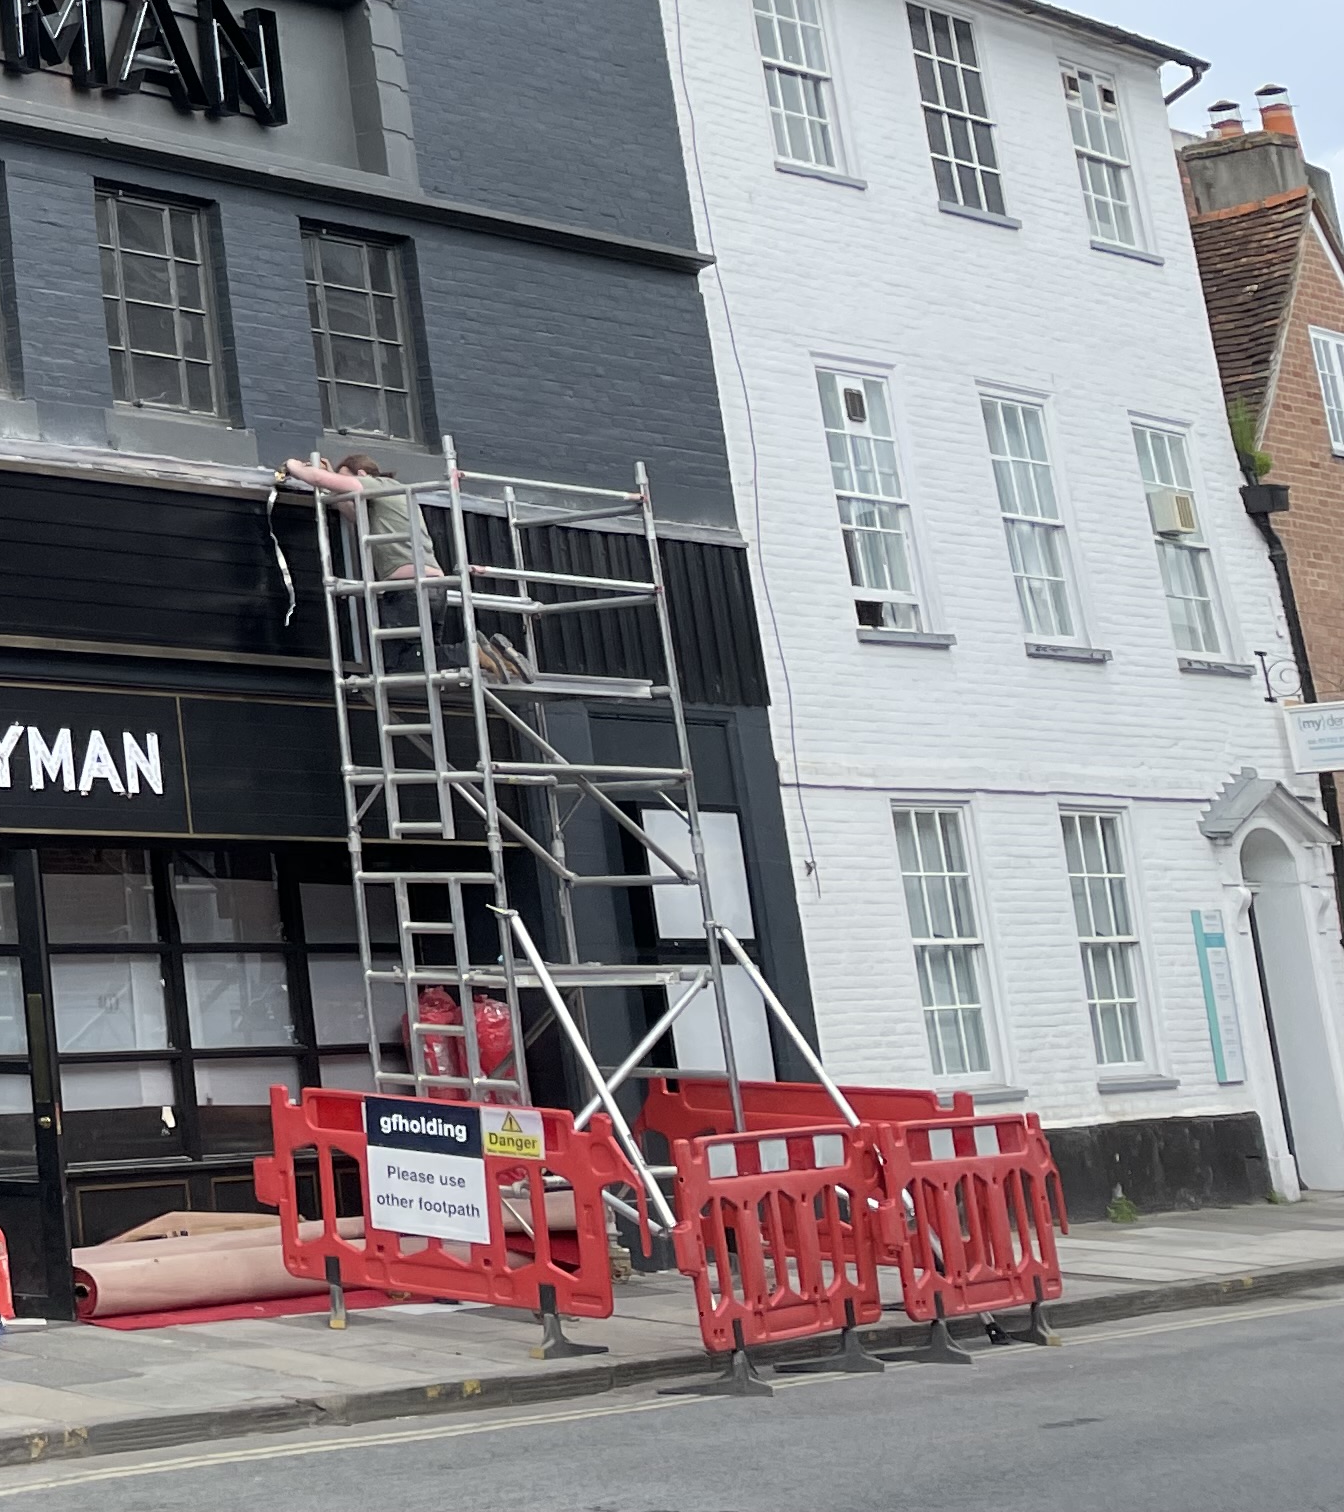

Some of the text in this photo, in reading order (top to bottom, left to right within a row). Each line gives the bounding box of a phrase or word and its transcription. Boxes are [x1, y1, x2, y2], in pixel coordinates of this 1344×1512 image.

[379, 1113, 467, 1142] gfholding
[488, 1131, 538, 1152] Danger
[386, 1165, 466, 1188] Please use
[376, 1193, 481, 1218] other footpath
